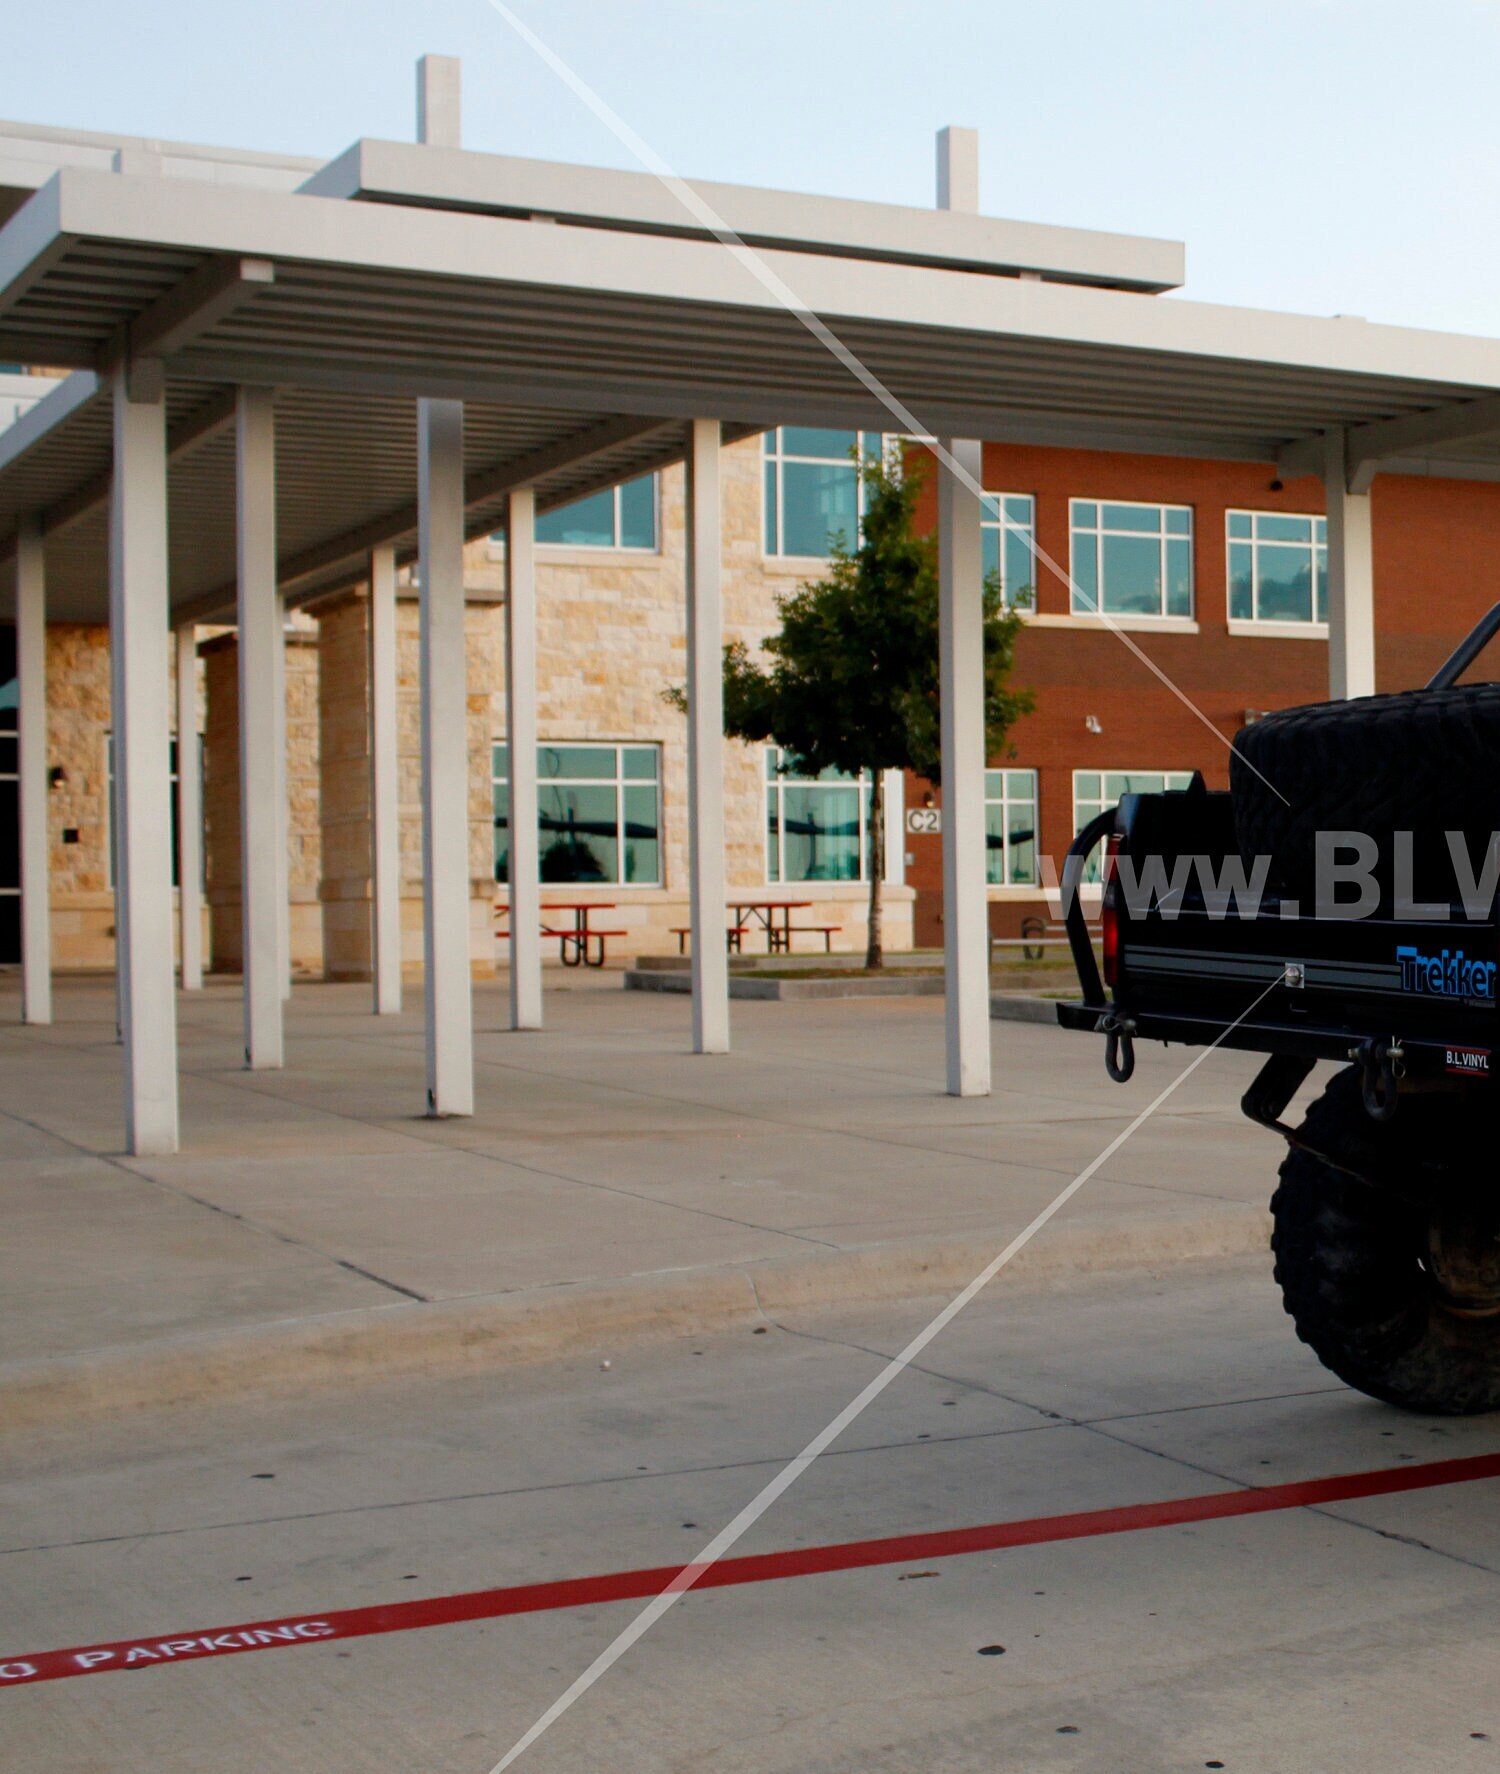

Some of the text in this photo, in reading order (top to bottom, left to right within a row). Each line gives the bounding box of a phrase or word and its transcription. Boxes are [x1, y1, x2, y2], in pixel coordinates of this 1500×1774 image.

[908, 810, 938, 831] C2
[1397, 945, 1497, 999] Trekker
[1446, 1051, 1489, 1069] B.L.VINYL
[72, 1621, 335, 1668] PARKING
